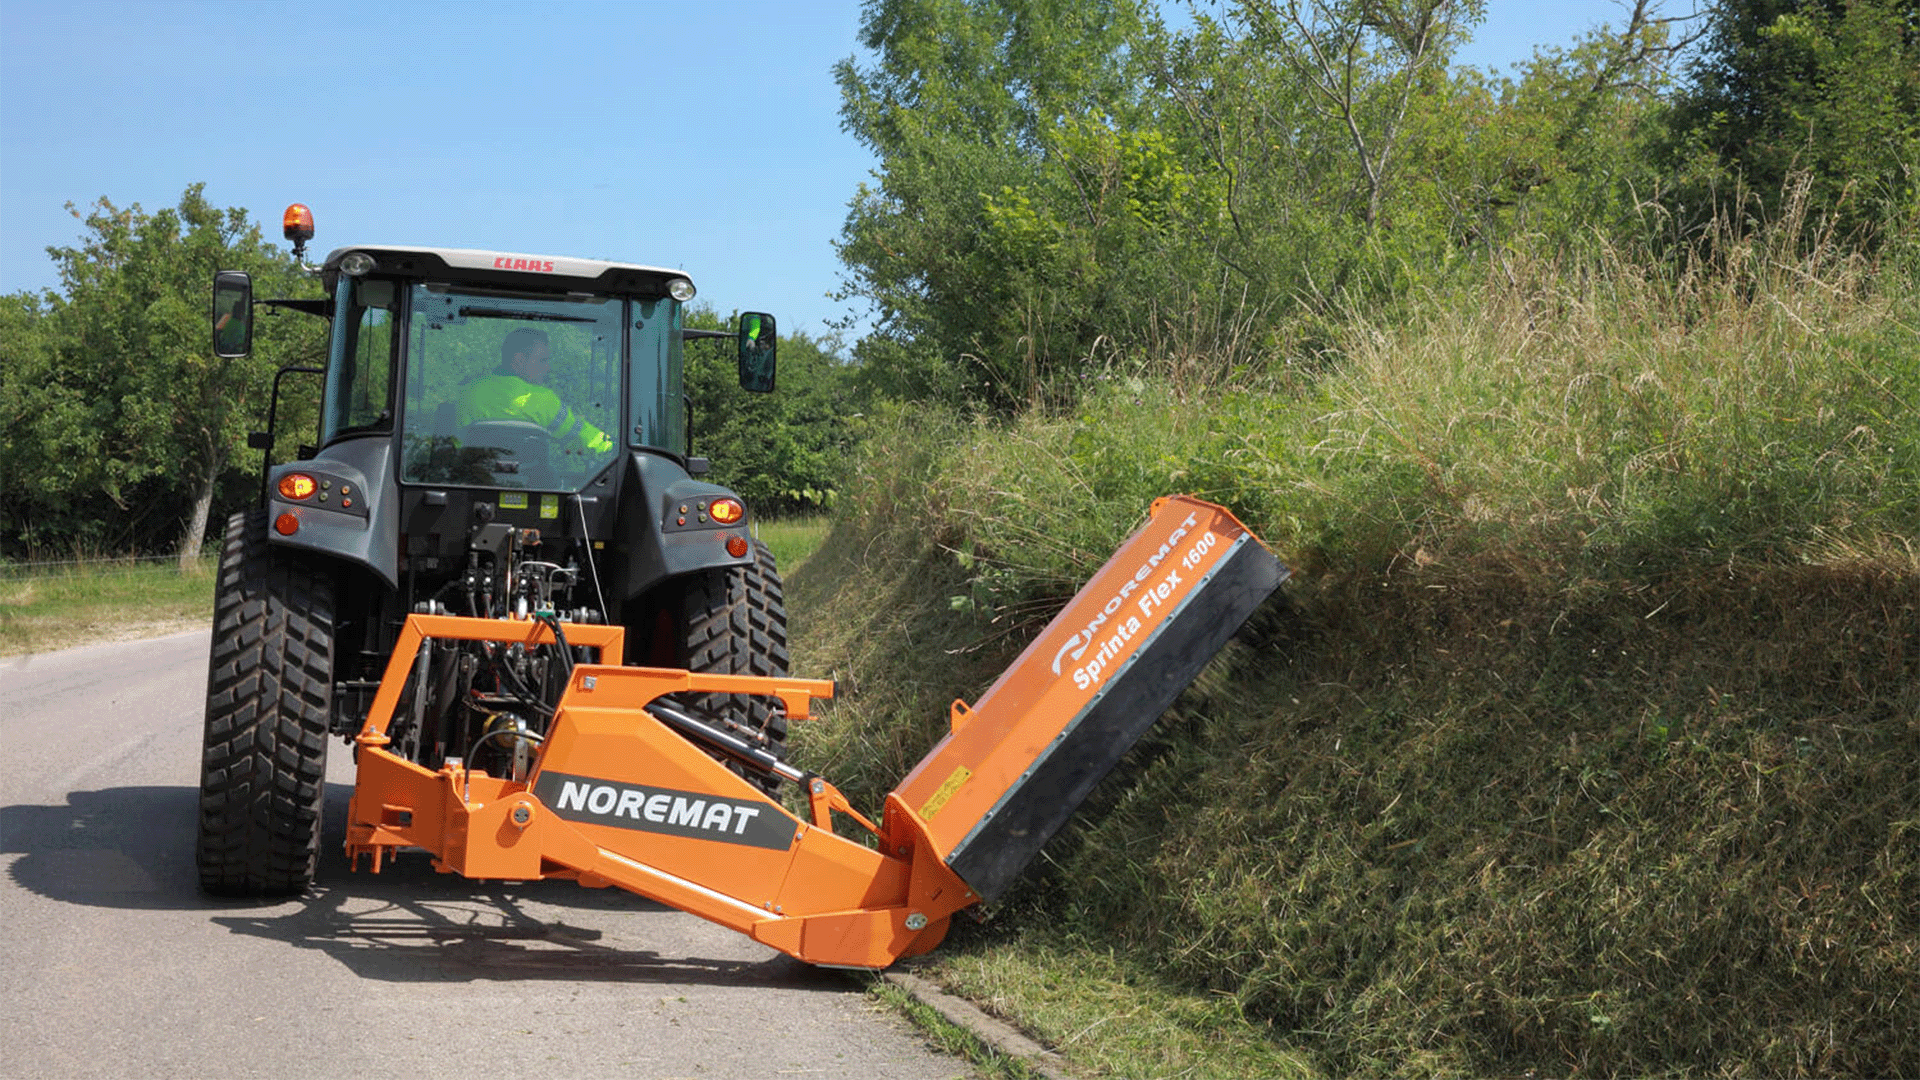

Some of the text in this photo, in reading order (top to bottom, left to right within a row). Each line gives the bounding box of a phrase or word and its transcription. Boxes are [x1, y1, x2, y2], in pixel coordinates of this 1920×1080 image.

[494, 257, 554, 272] CLAAS
[1073, 531, 1216, 690] Sprinta Flex 1600
[1087, 511, 1197, 633] NOREMAT
[556, 781, 760, 834] NOREMAT
